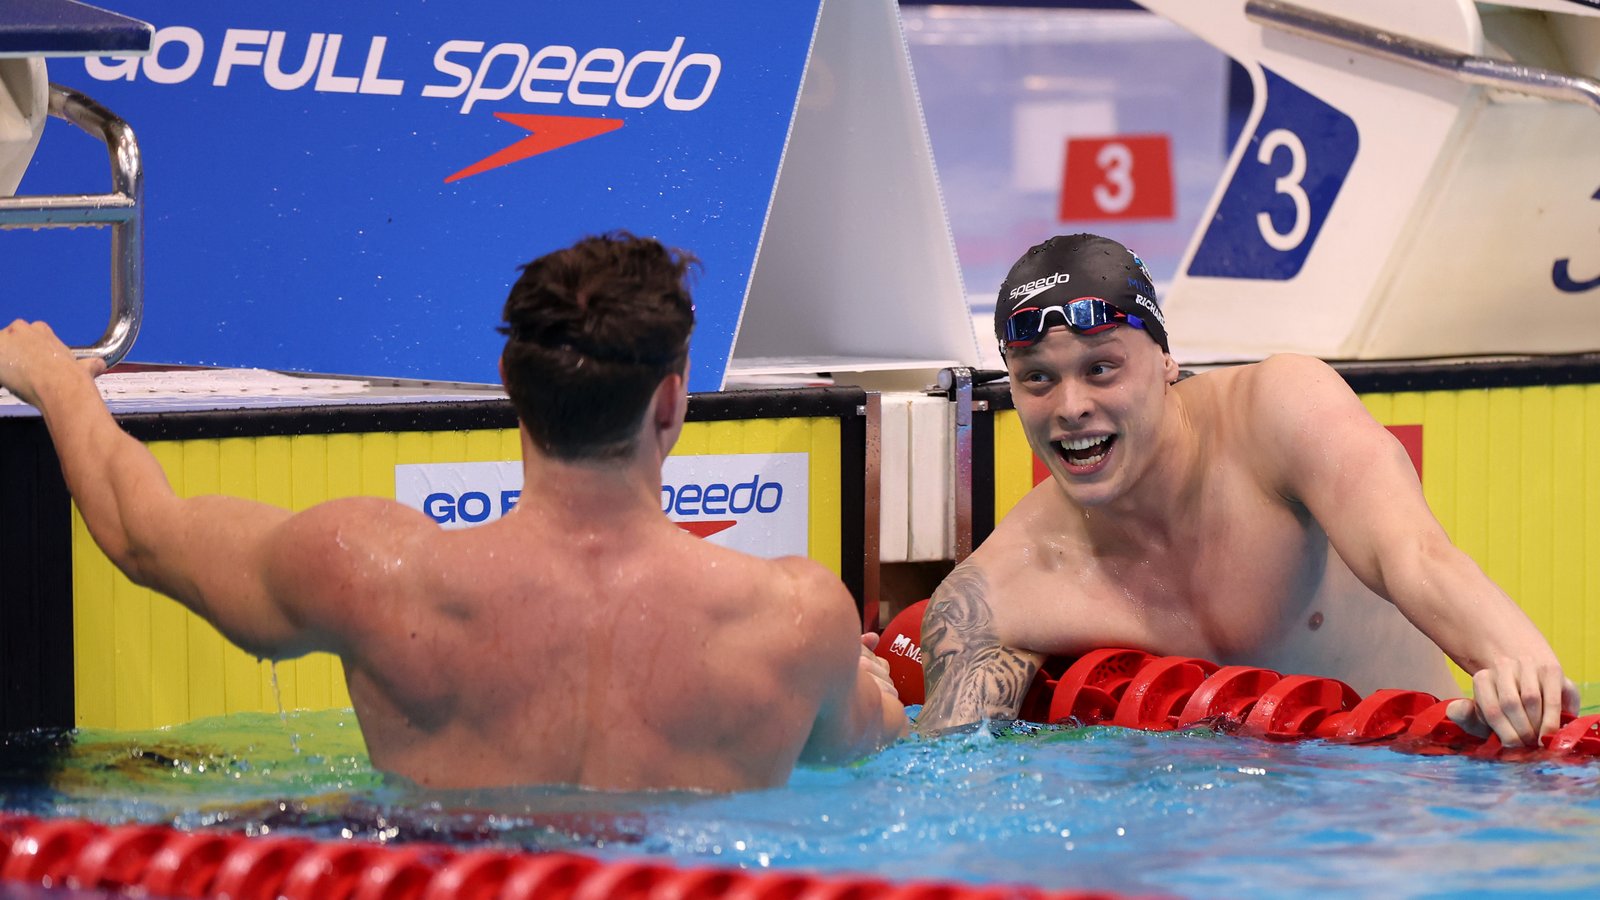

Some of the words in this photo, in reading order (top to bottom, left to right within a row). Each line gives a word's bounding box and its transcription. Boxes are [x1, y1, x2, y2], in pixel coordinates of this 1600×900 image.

[212, 28, 405, 95] FULL
[421, 36, 722, 114] speedo
[1093, 142, 1135, 213] 3
[1256, 128, 1311, 251] 3
[1009, 272, 1070, 299] speedo
[423, 491, 492, 524] GO
[661, 474, 783, 515] eedo
